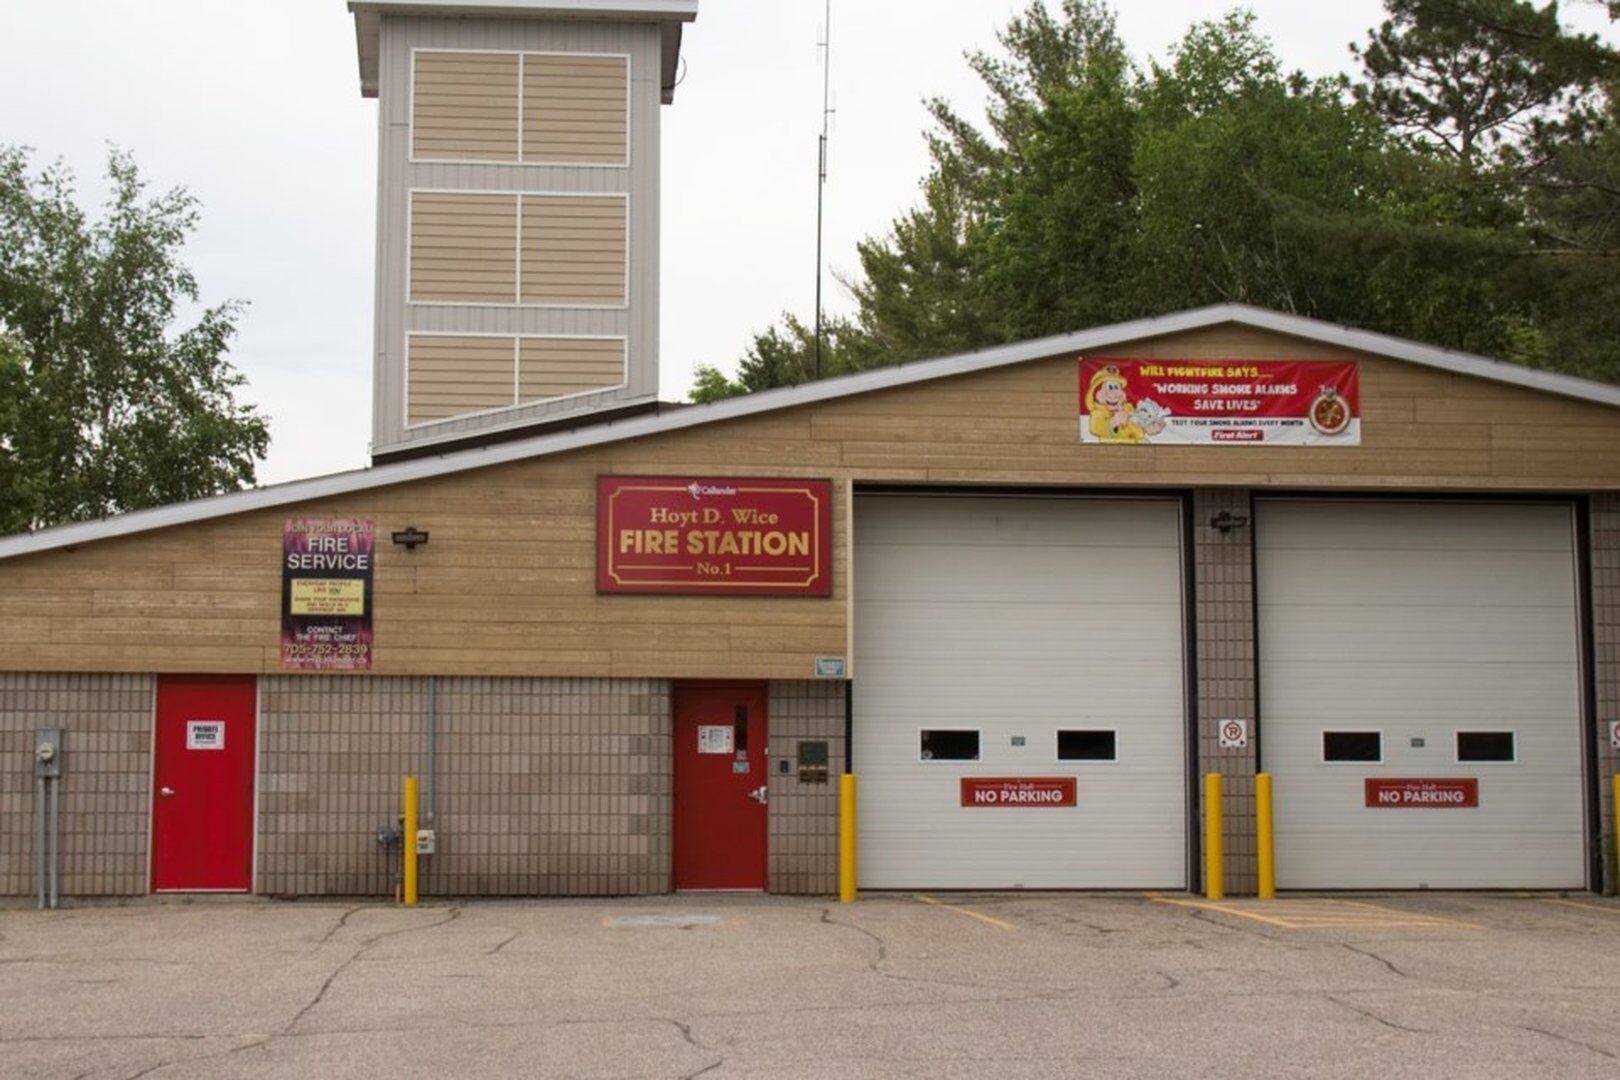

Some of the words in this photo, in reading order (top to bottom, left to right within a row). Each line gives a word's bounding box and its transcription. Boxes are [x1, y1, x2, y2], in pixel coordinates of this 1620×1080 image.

[1140, 366, 1165, 376] WILL
[1167, 367, 1224, 377] FIGHTFIRE
[1211, 384, 1252, 395] SMOKE
[1255, 384, 1297, 395] ALARMS
[1193, 399, 1225, 410] SAVE
[1213, 431, 1234, 439] First
[1235, 431, 1259, 439] Alert
[650, 507, 698, 528] Hoyt
[703, 508, 725, 525] D.
[731, 509, 779, 525] Wice
[308, 537, 349, 553] FIRE
[620, 529, 679, 554] FIRE
[686, 530, 809, 556] STATION
[287, 553, 369, 570] SERVICE
[306, 626, 343, 634] CONTACT
[296, 633, 313, 641] THE
[315, 633, 332, 641] FIRE
[333, 634, 356, 642] CHIEF
[974, 790, 998, 802] NO
[1000, 790, 1063, 803] PARKING
[1378, 790, 1401, 803] NO
[1403, 790, 1465, 803] PARKING
